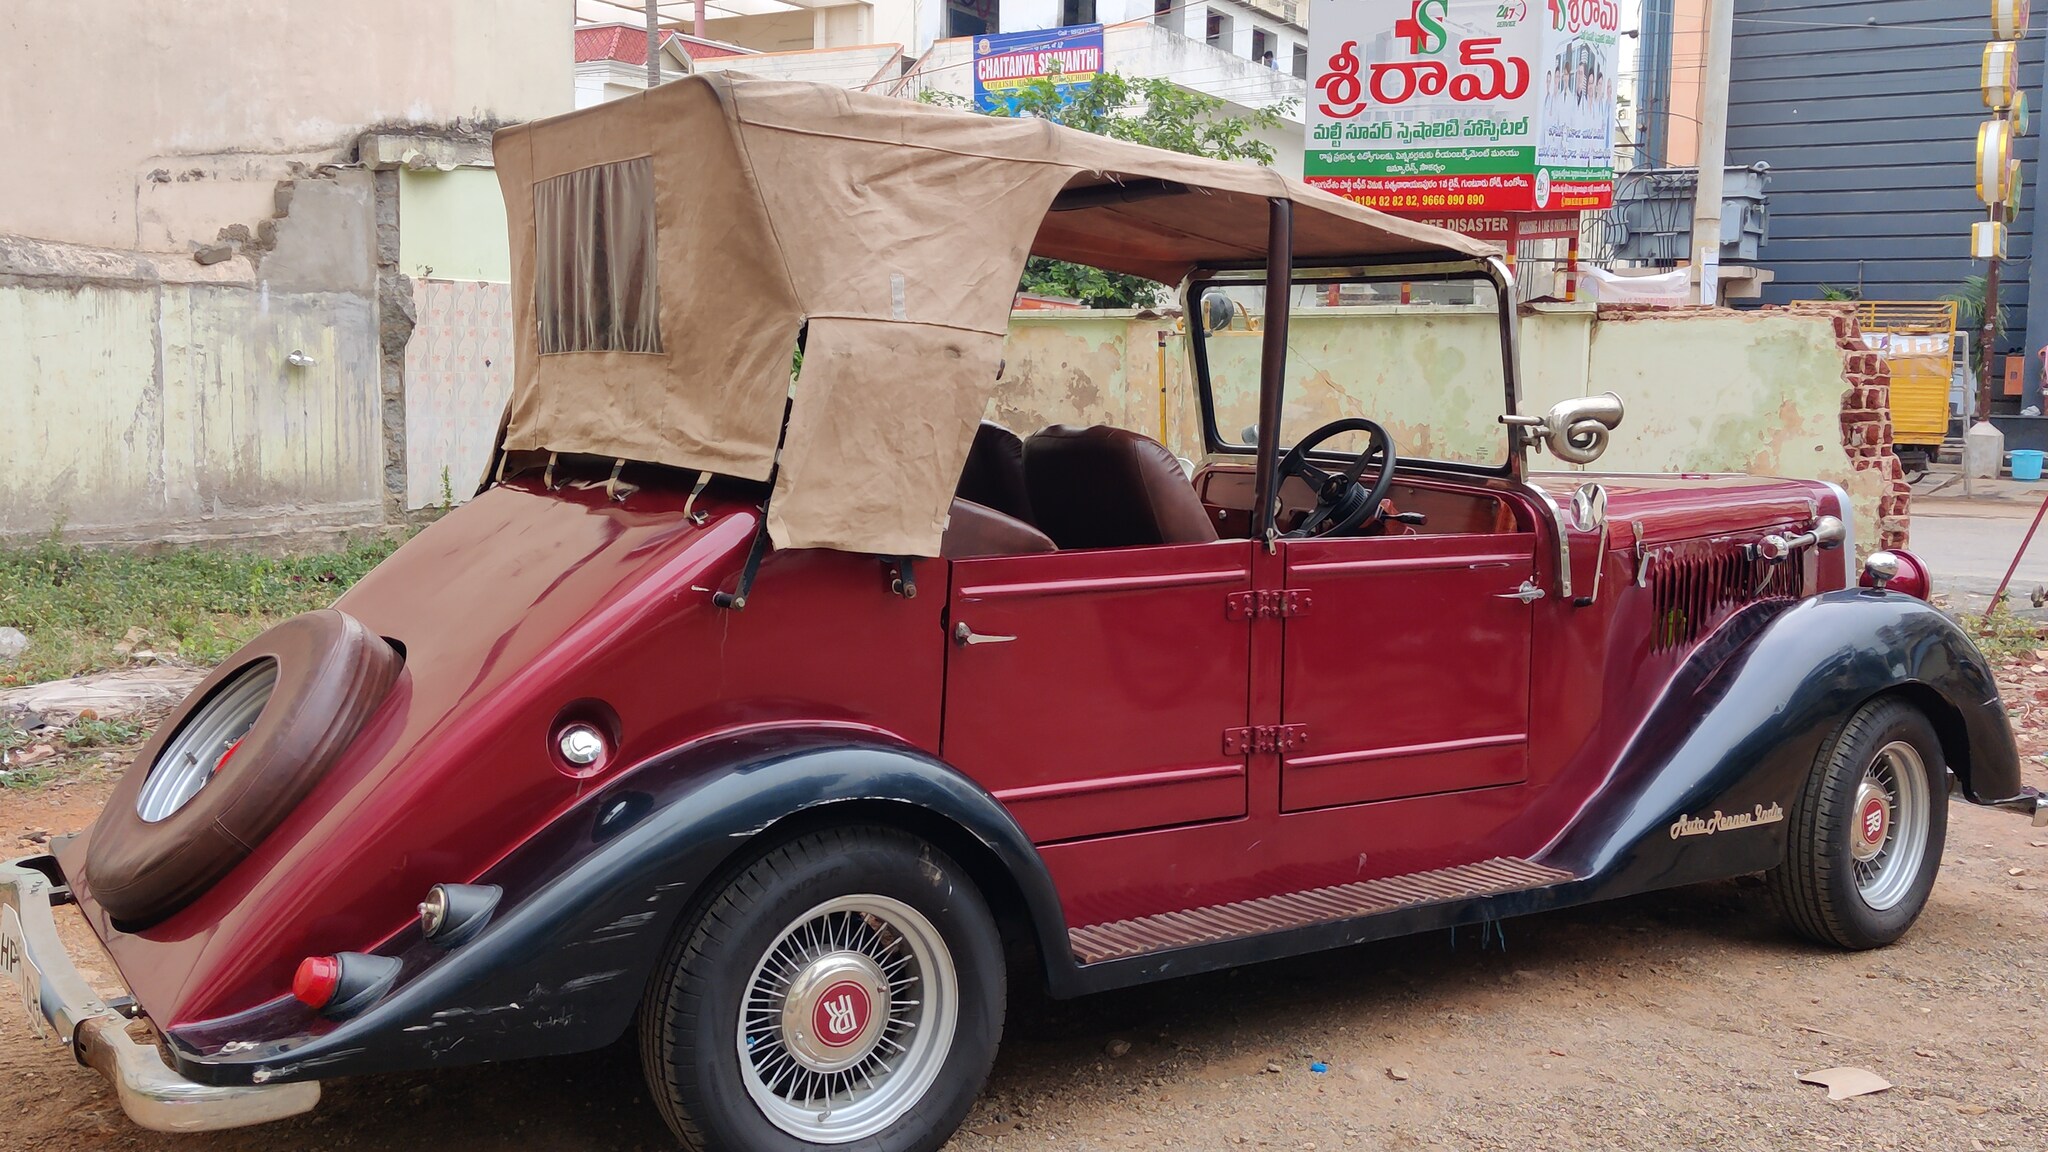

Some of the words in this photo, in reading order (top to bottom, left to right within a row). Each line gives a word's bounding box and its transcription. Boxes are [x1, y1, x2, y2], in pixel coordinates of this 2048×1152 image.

[979, 54, 1036, 80] CHAITANYA
[1315, 37, 1530, 119] శ్రీరామ్
[1355, 195, 1376, 206] 8184
[1379, 195, 1390, 207] 82
[1392, 195, 1404, 206] 82
[1405, 194, 1420, 207] 82,
[1422, 194, 1446, 206] 9666
[1447, 194, 1465, 206] 890
[1467, 194, 1485, 206] 890
[1447, 217, 1509, 233] DISASTER
[1670, 813, 1707, 840] Auto
